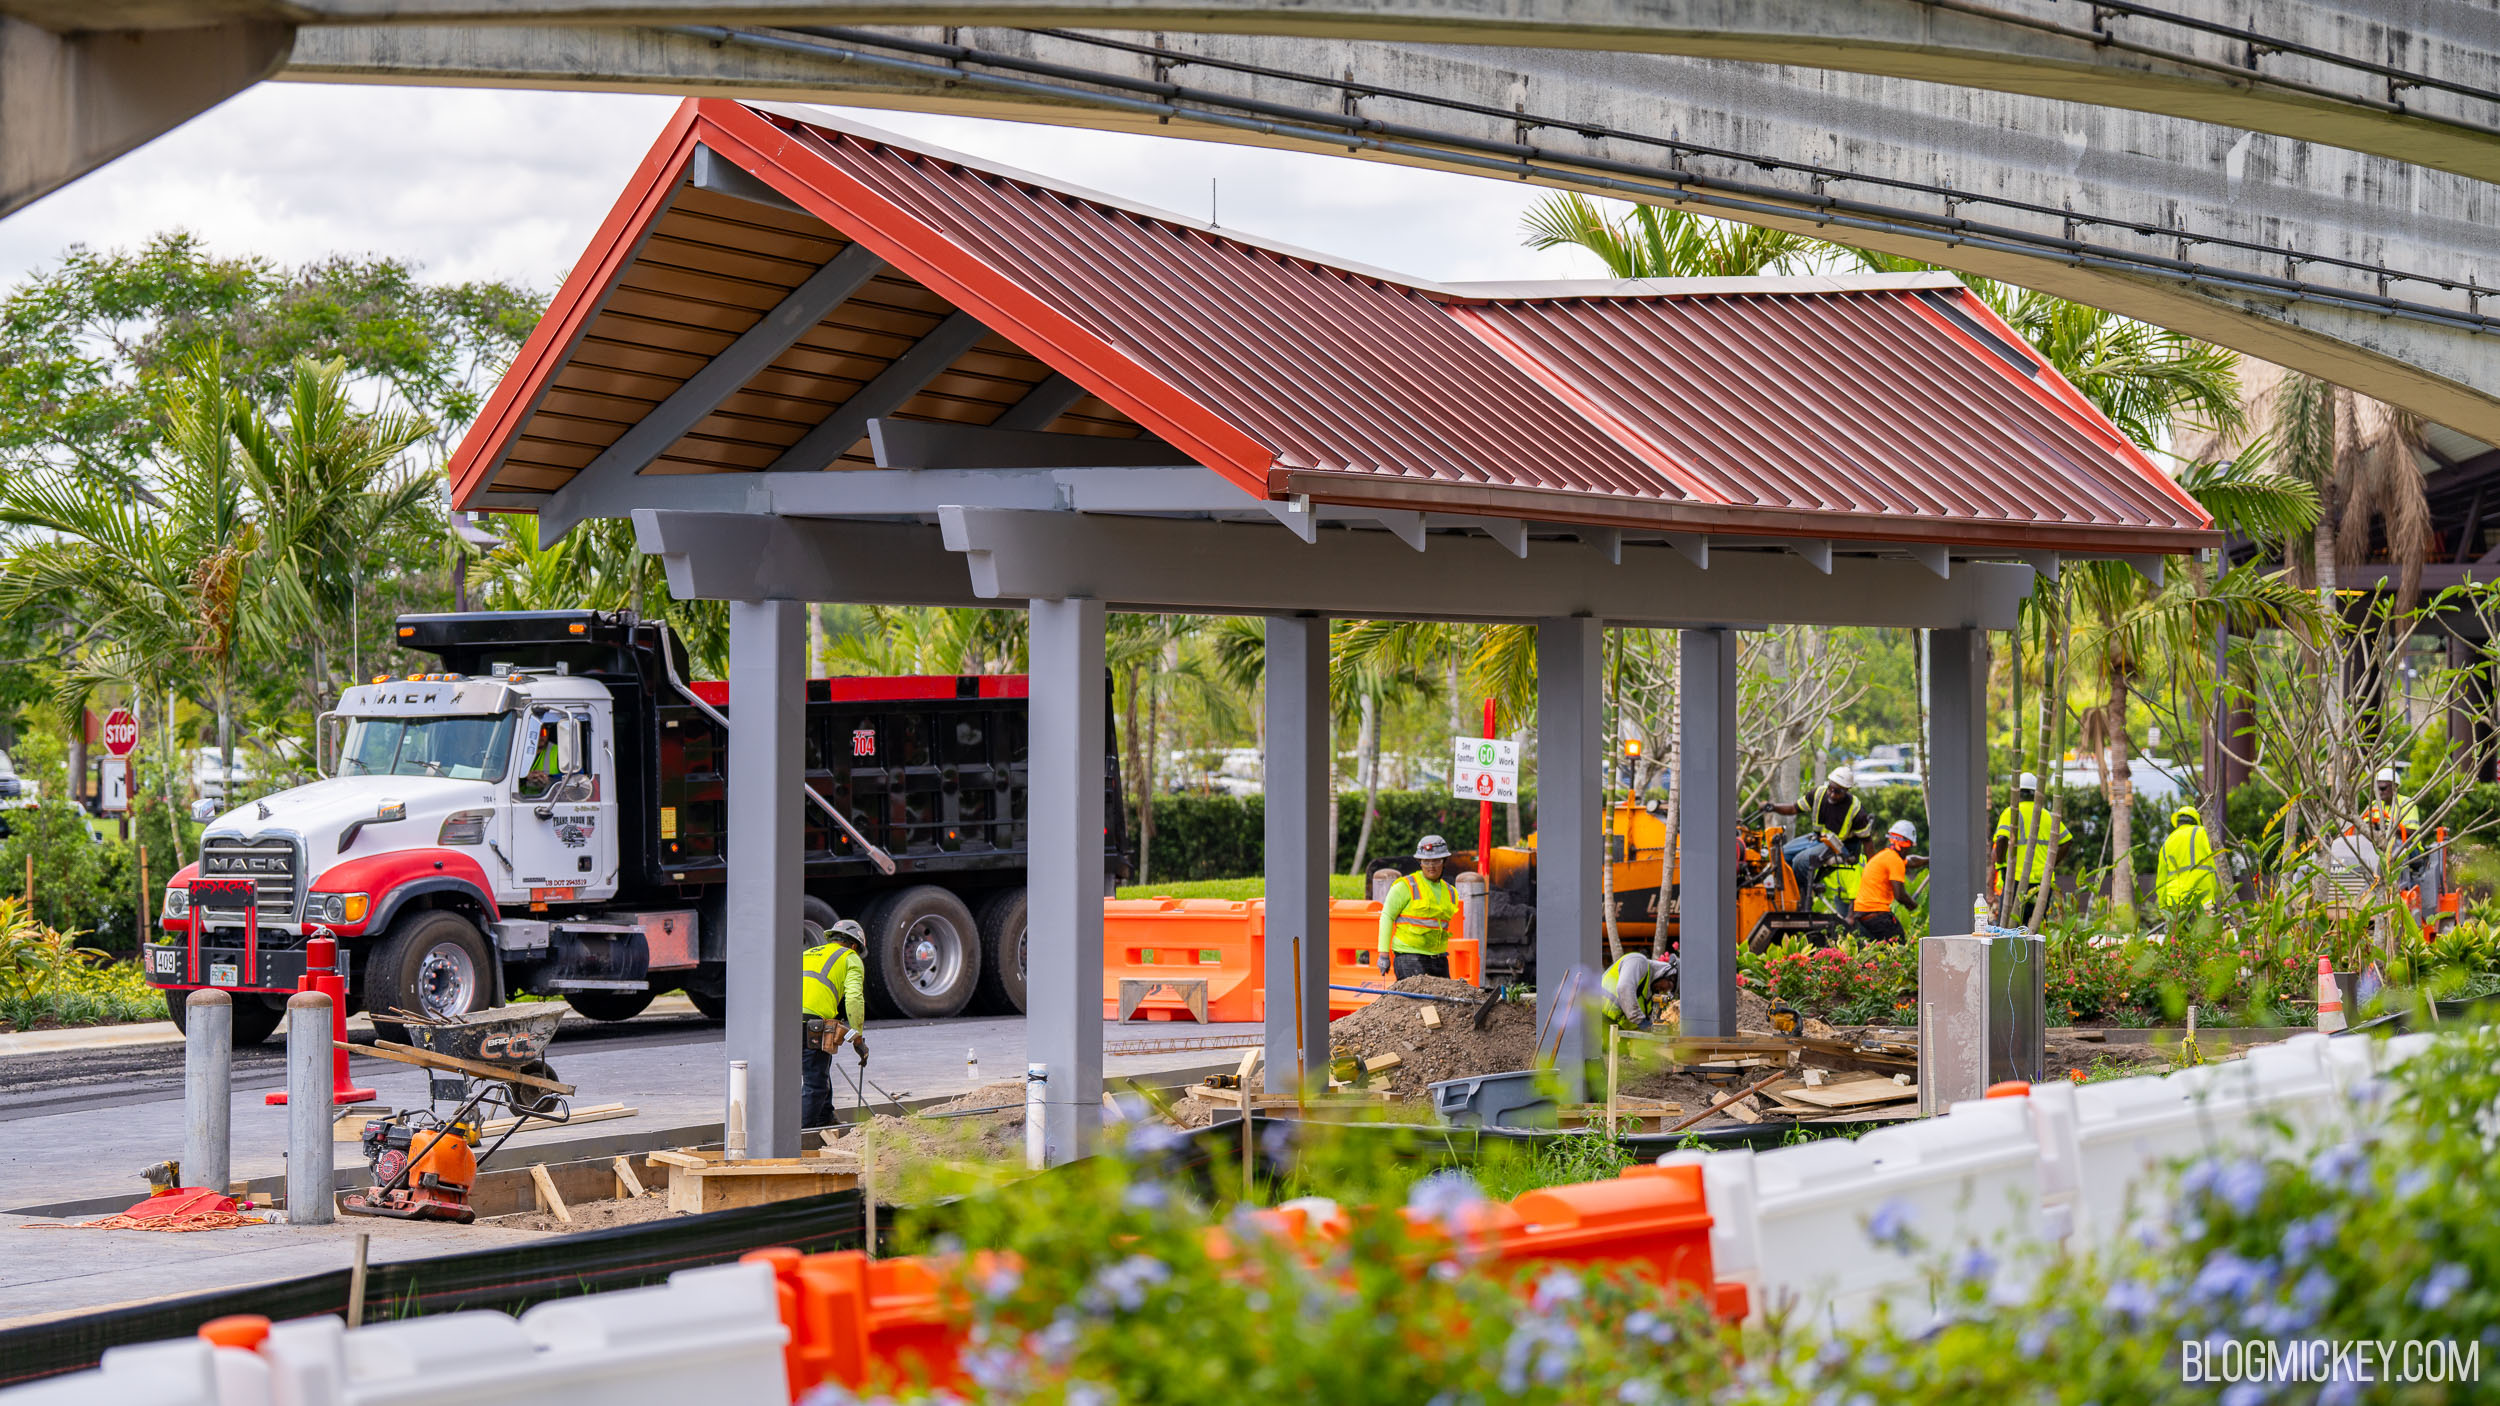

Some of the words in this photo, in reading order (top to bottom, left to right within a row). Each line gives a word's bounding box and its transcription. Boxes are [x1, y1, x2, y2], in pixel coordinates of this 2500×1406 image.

[106, 724, 135, 743] STOP
[853, 737, 875, 756] 704
[1462, 742, 1471, 750] See
[1504, 746, 1511, 754] To
[1480, 747, 1493, 763] GO
[1499, 758, 1514, 766] Work
[1501, 776, 1511, 785] NO
[1456, 784, 1473, 794] Spotter
[1497, 789, 1513, 797] Work
[208, 858, 288, 871] MACK
[158, 954, 174, 971] 409
